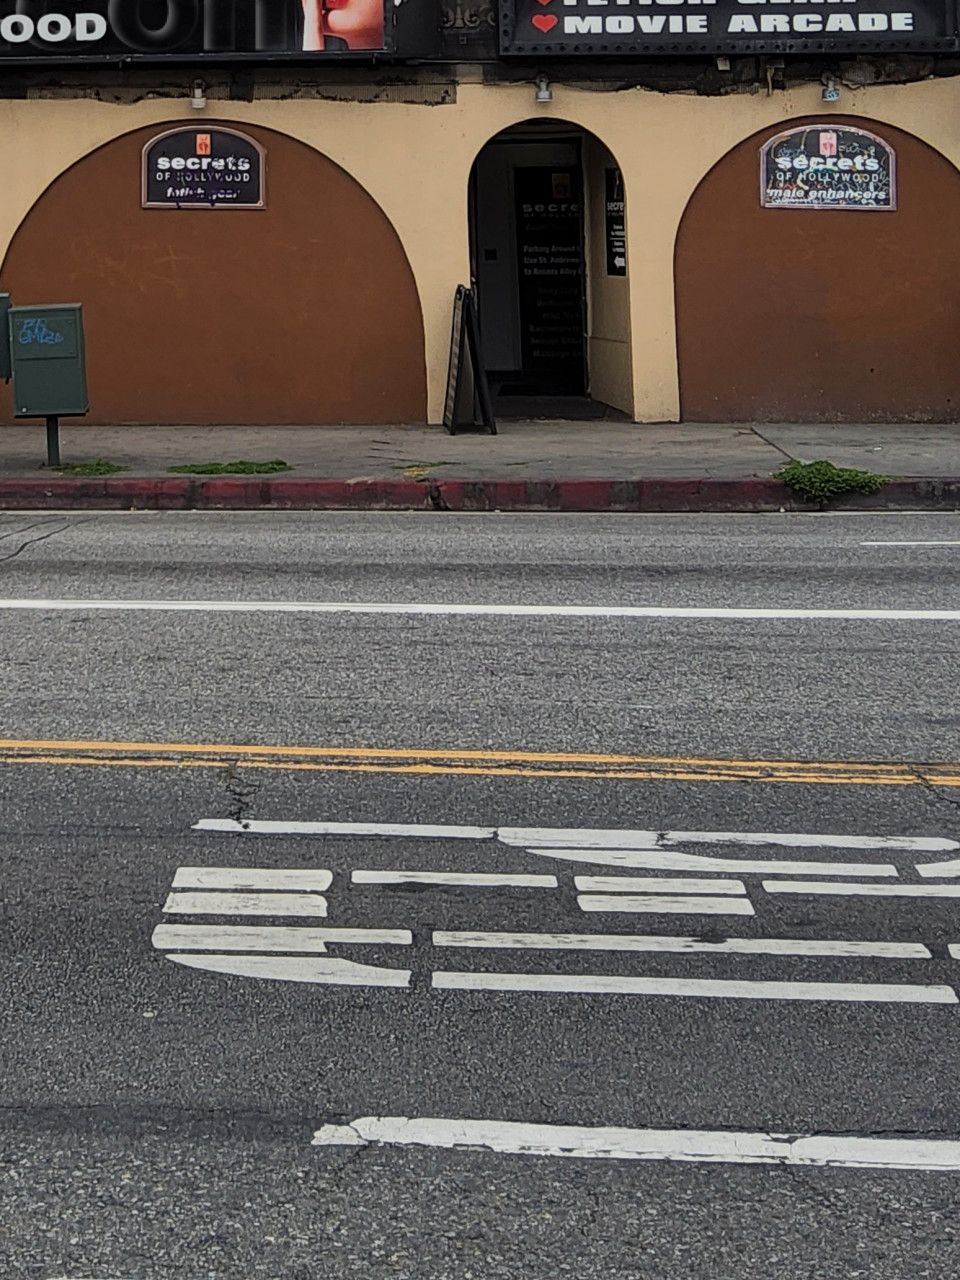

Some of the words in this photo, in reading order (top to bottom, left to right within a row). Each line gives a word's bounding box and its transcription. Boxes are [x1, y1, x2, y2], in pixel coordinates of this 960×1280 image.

[563, 15, 709, 35] MOVIE
[727, 12, 915, 33] ARCADE
[157, 156, 251, 171] secrets
[775, 154, 880, 171] secrets
[156, 172, 171, 181] OF
[776, 172, 793, 181] OF
[800, 173, 879, 182] HOLLYWOOD
[769, 187, 804, 197] male
[808, 186, 886, 200] enhancers
